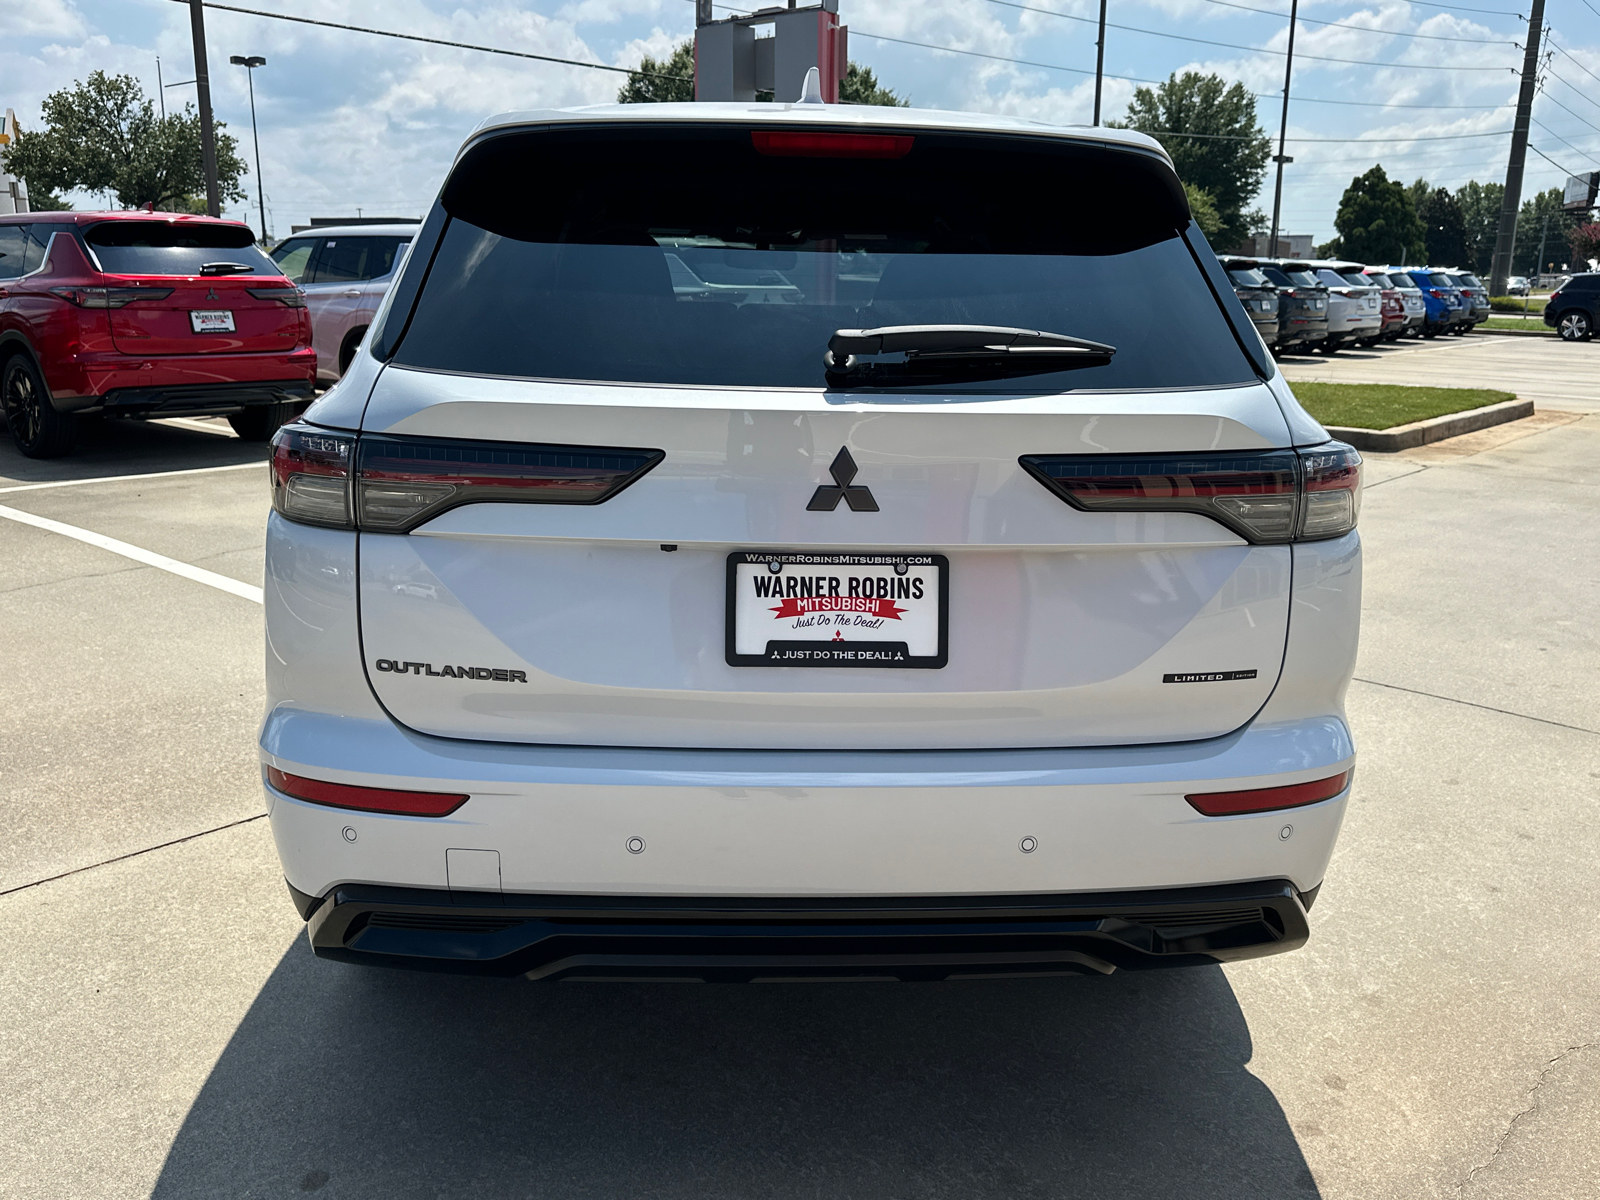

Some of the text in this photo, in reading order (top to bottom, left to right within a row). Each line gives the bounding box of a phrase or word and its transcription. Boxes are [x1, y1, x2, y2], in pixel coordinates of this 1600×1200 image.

[753, 575, 924, 600] WARNER ROBINS
[796, 597, 880, 613] MITSUBISHI
[791, 613, 885, 630] Just Do The Deal!
[782, 650, 892, 660] JUST DO THE DEAL!
[375, 658, 528, 684] OUTLANDER
[1174, 674, 1224, 682] LIMITED
